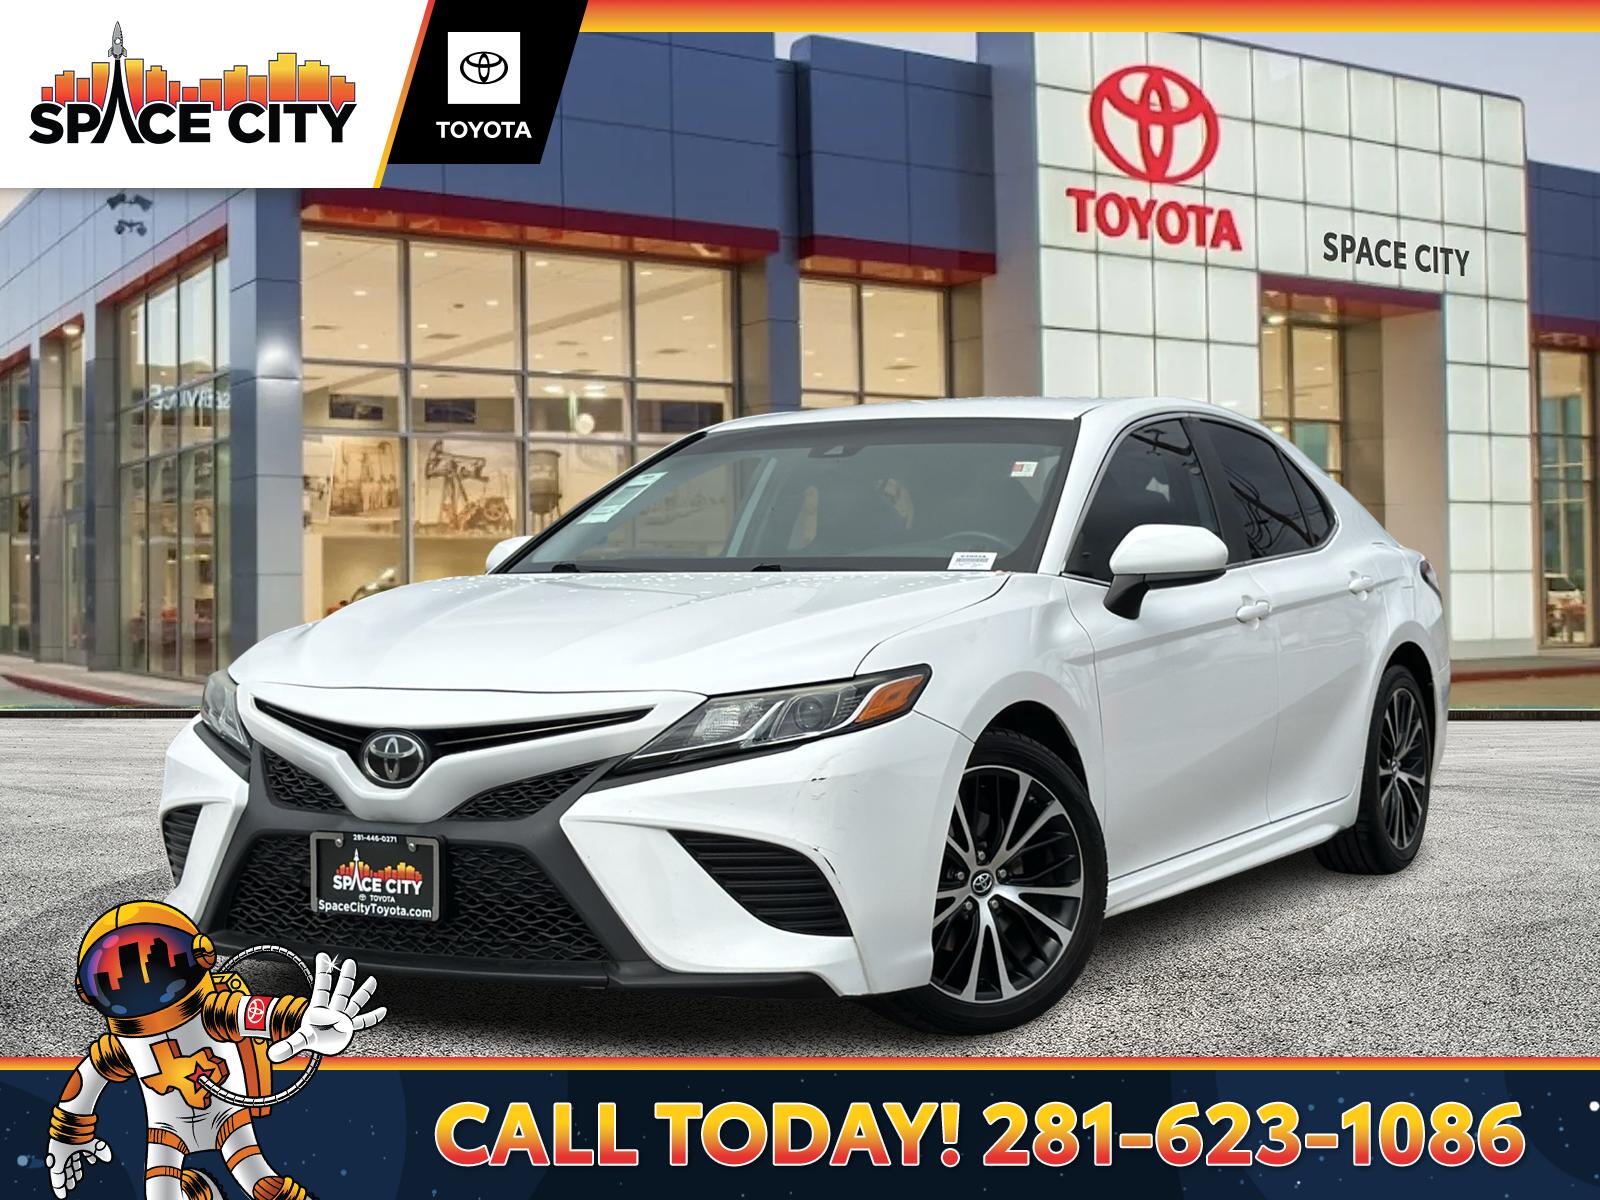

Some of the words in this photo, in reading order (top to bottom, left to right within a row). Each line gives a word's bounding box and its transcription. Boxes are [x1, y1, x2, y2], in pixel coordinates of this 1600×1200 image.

[1066, 187, 1243, 252] TOYOTA
[1322, 231, 1407, 270] SPACE
[1414, 243, 1471, 277] CITY
[352, 833, 398, 843] 281-446-0271
[332, 875, 382, 892] SPACE
[385, 879, 423, 896] CITY
[369, 894, 396, 903] TOYOTA
[318, 899, 432, 919] SpaceCityToyota.com
